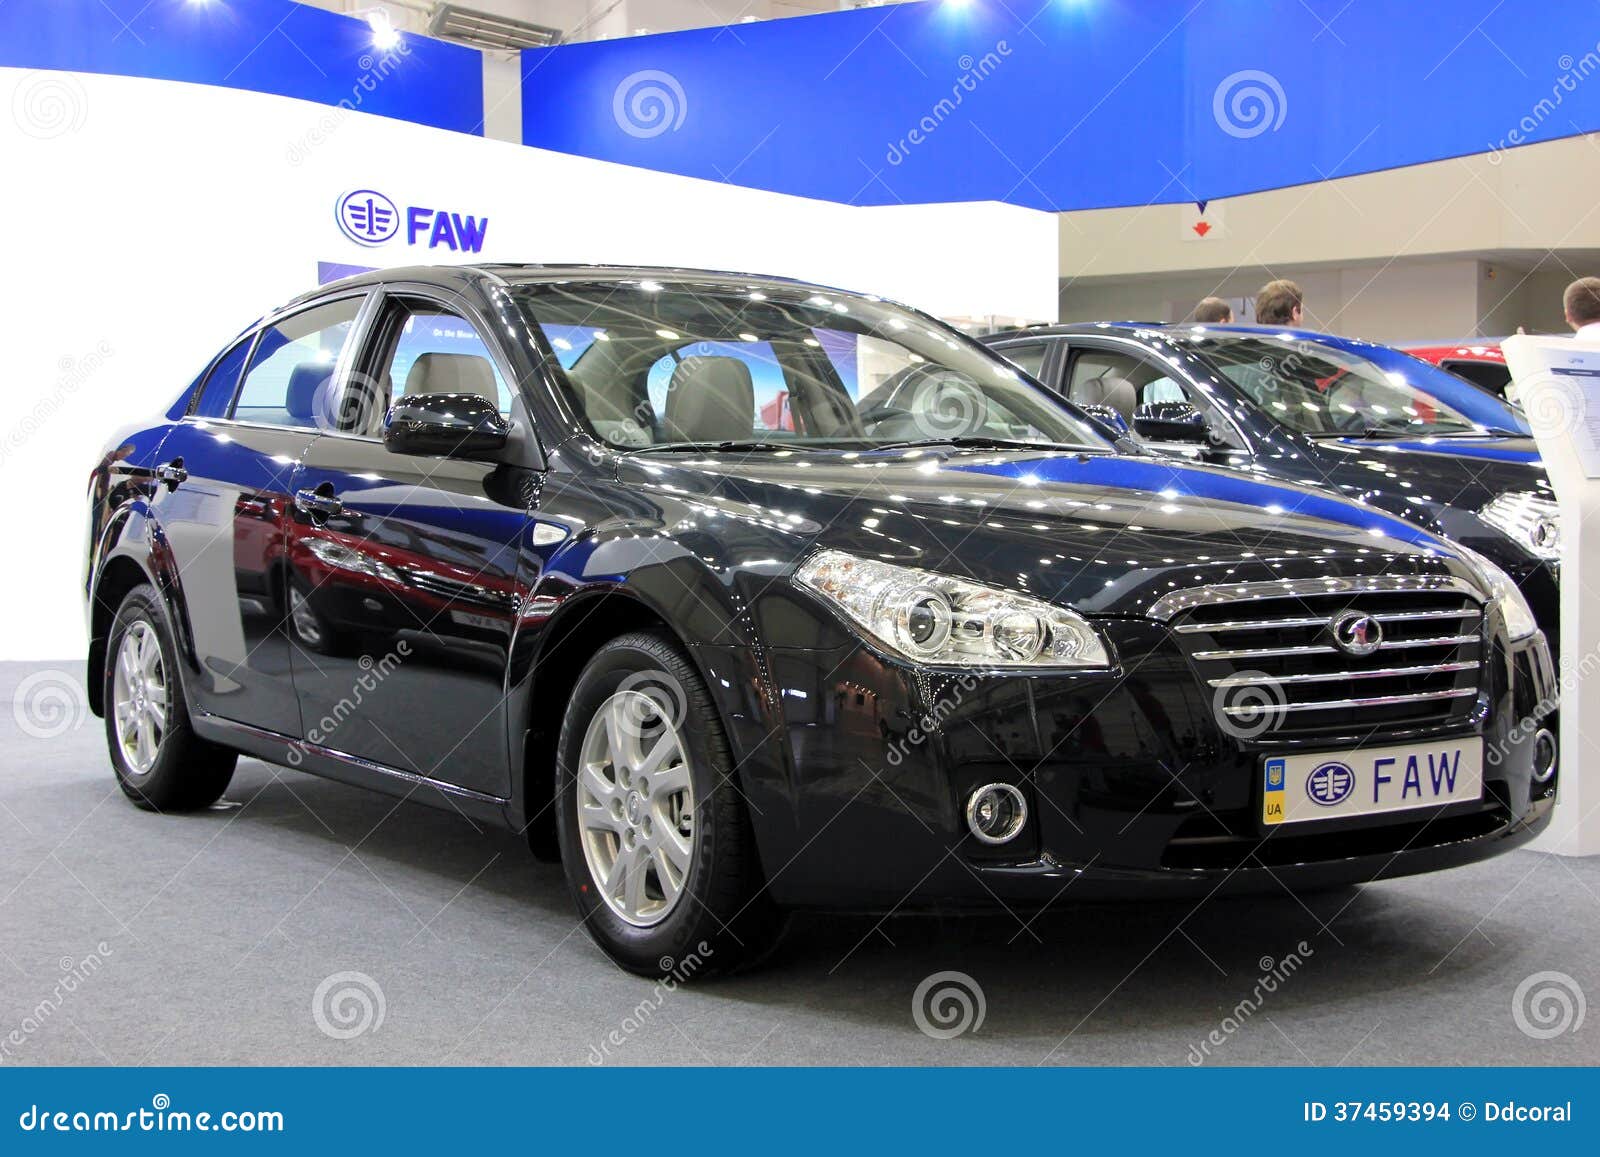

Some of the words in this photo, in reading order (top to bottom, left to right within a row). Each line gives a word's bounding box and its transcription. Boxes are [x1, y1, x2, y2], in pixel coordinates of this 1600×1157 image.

[407, 206, 488, 254] FAW
[1373, 750, 1461, 803] FAW
[1266, 804, 1282, 815] UA
